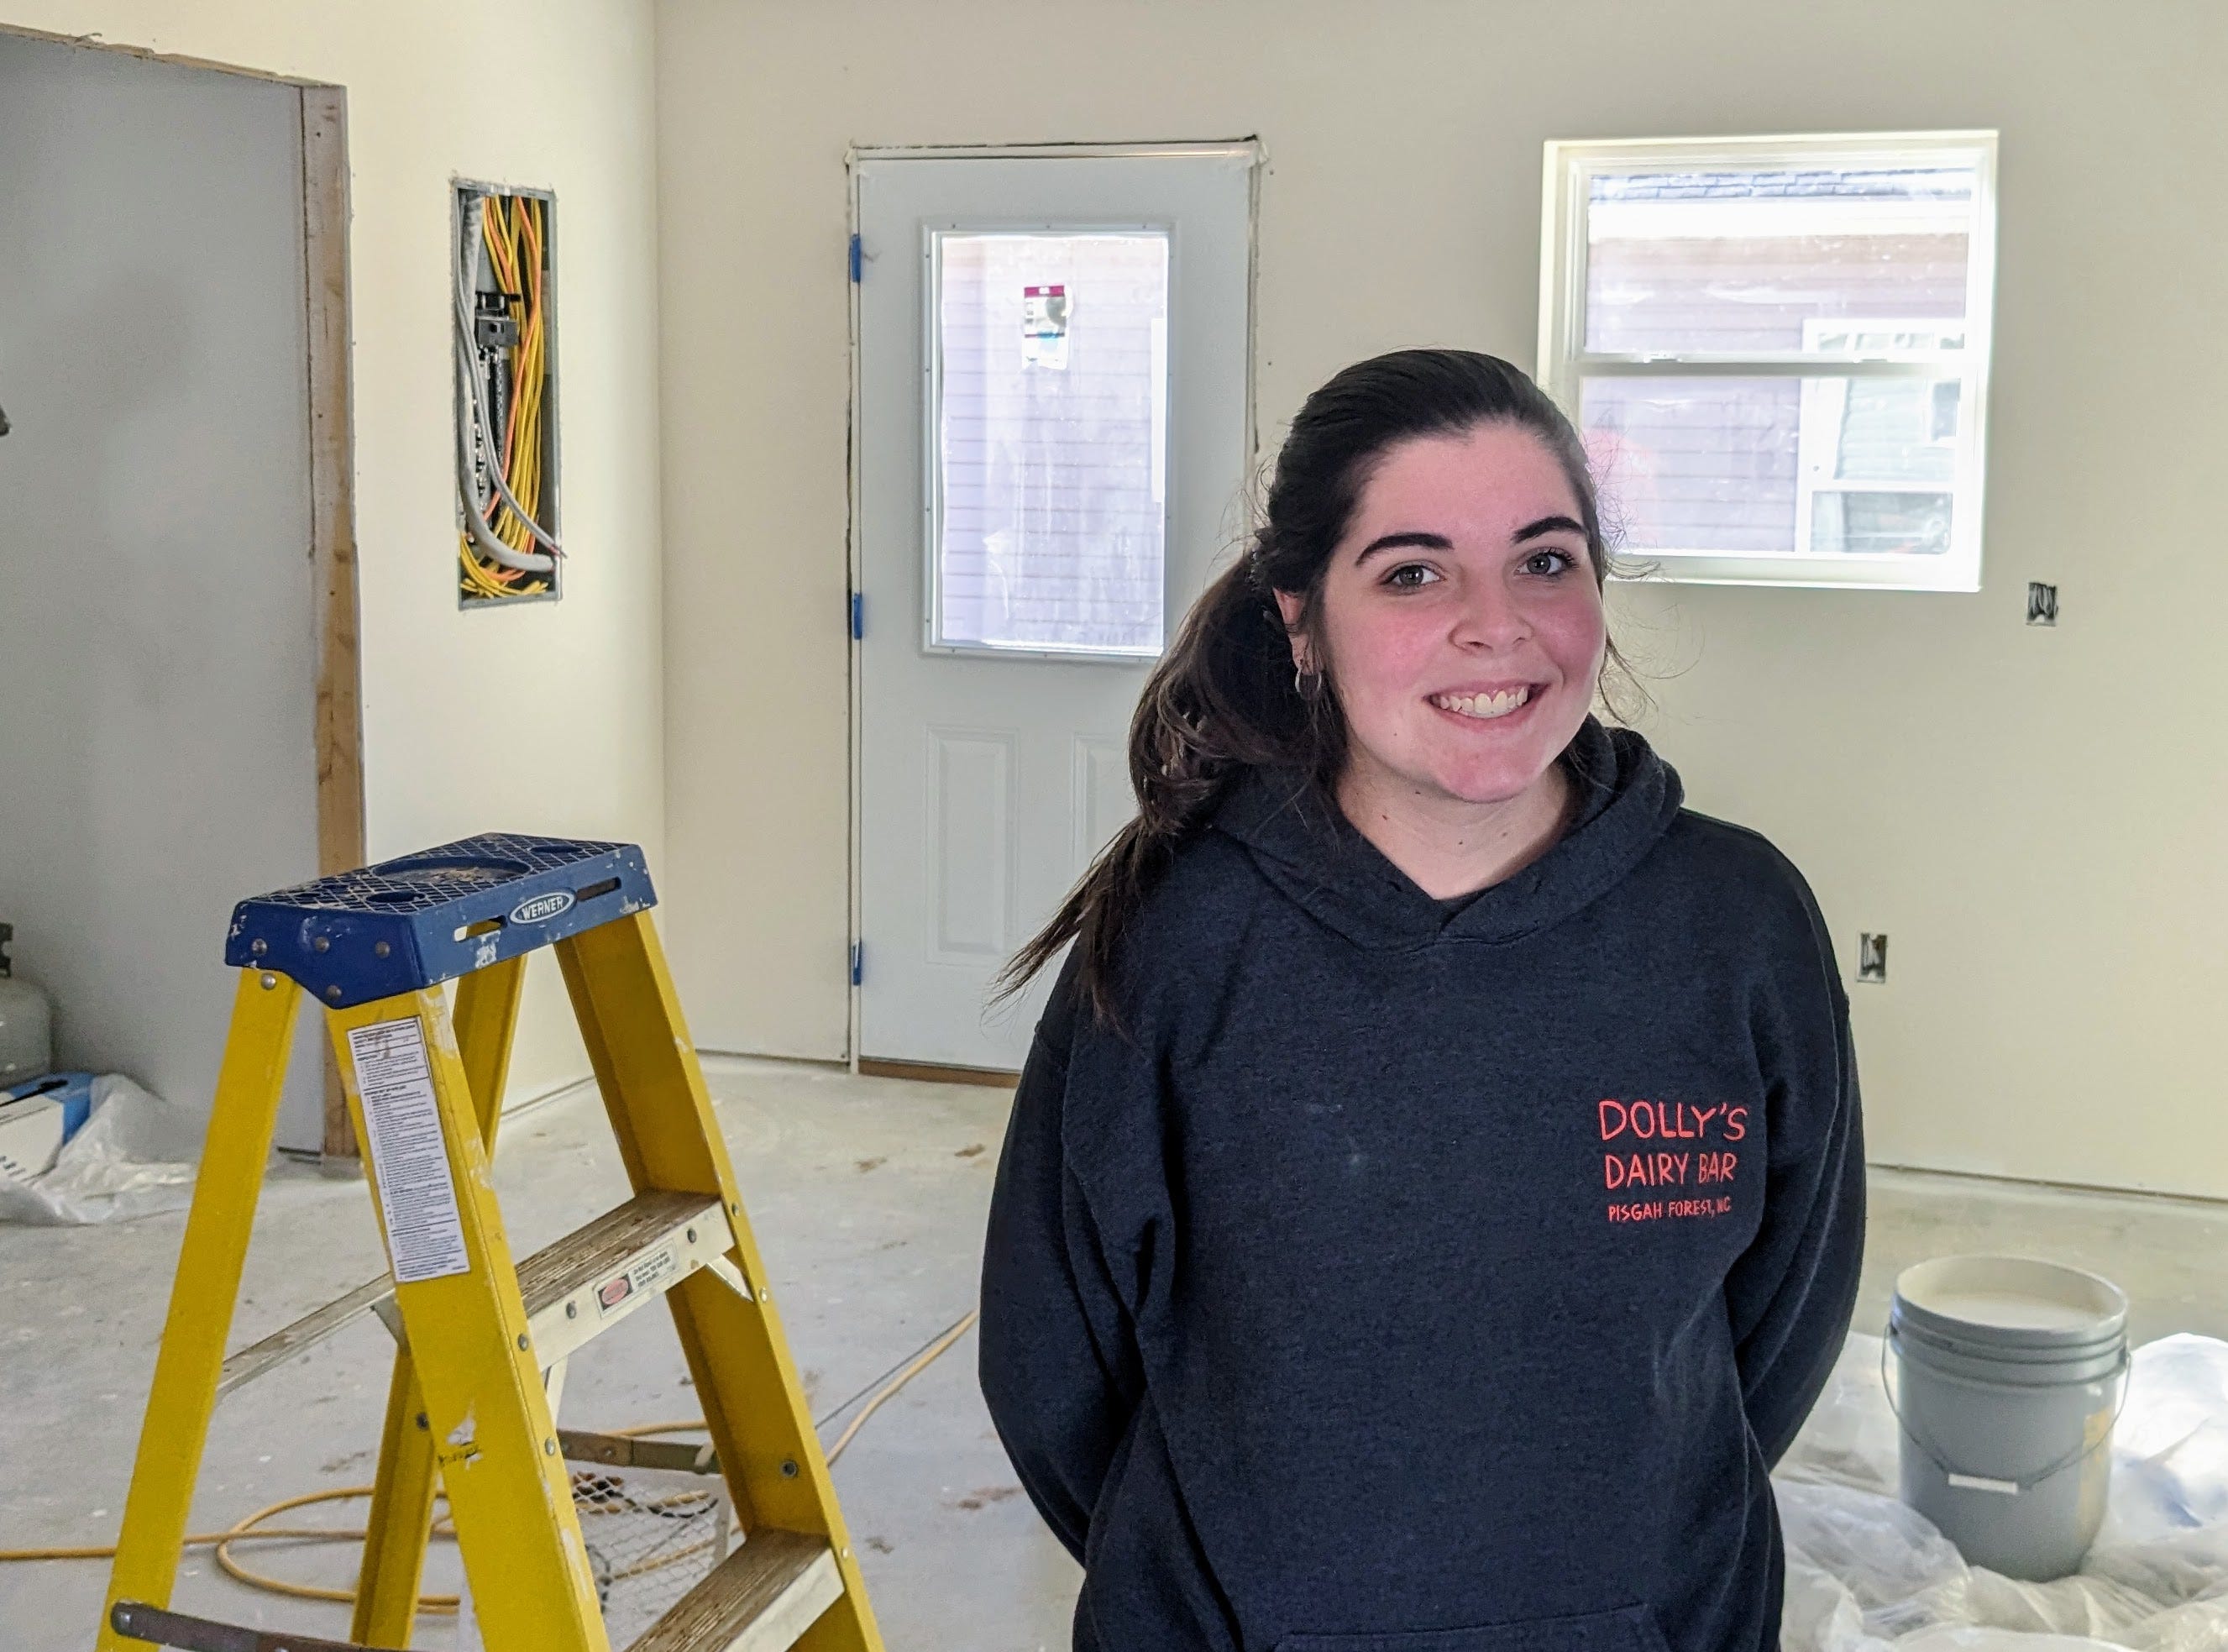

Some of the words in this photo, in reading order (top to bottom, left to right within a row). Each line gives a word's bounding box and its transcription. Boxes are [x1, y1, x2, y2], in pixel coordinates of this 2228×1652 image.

[522, 896, 564, 920] WERNER
[1598, 1099, 1748, 1141] DOLLY'S
[1605, 1152, 1690, 1190] DAIRY
[1698, 1151, 1738, 1184] BAR
[1608, 1201, 1663, 1223] PISGAH
[1717, 1196, 1732, 1214] NC
